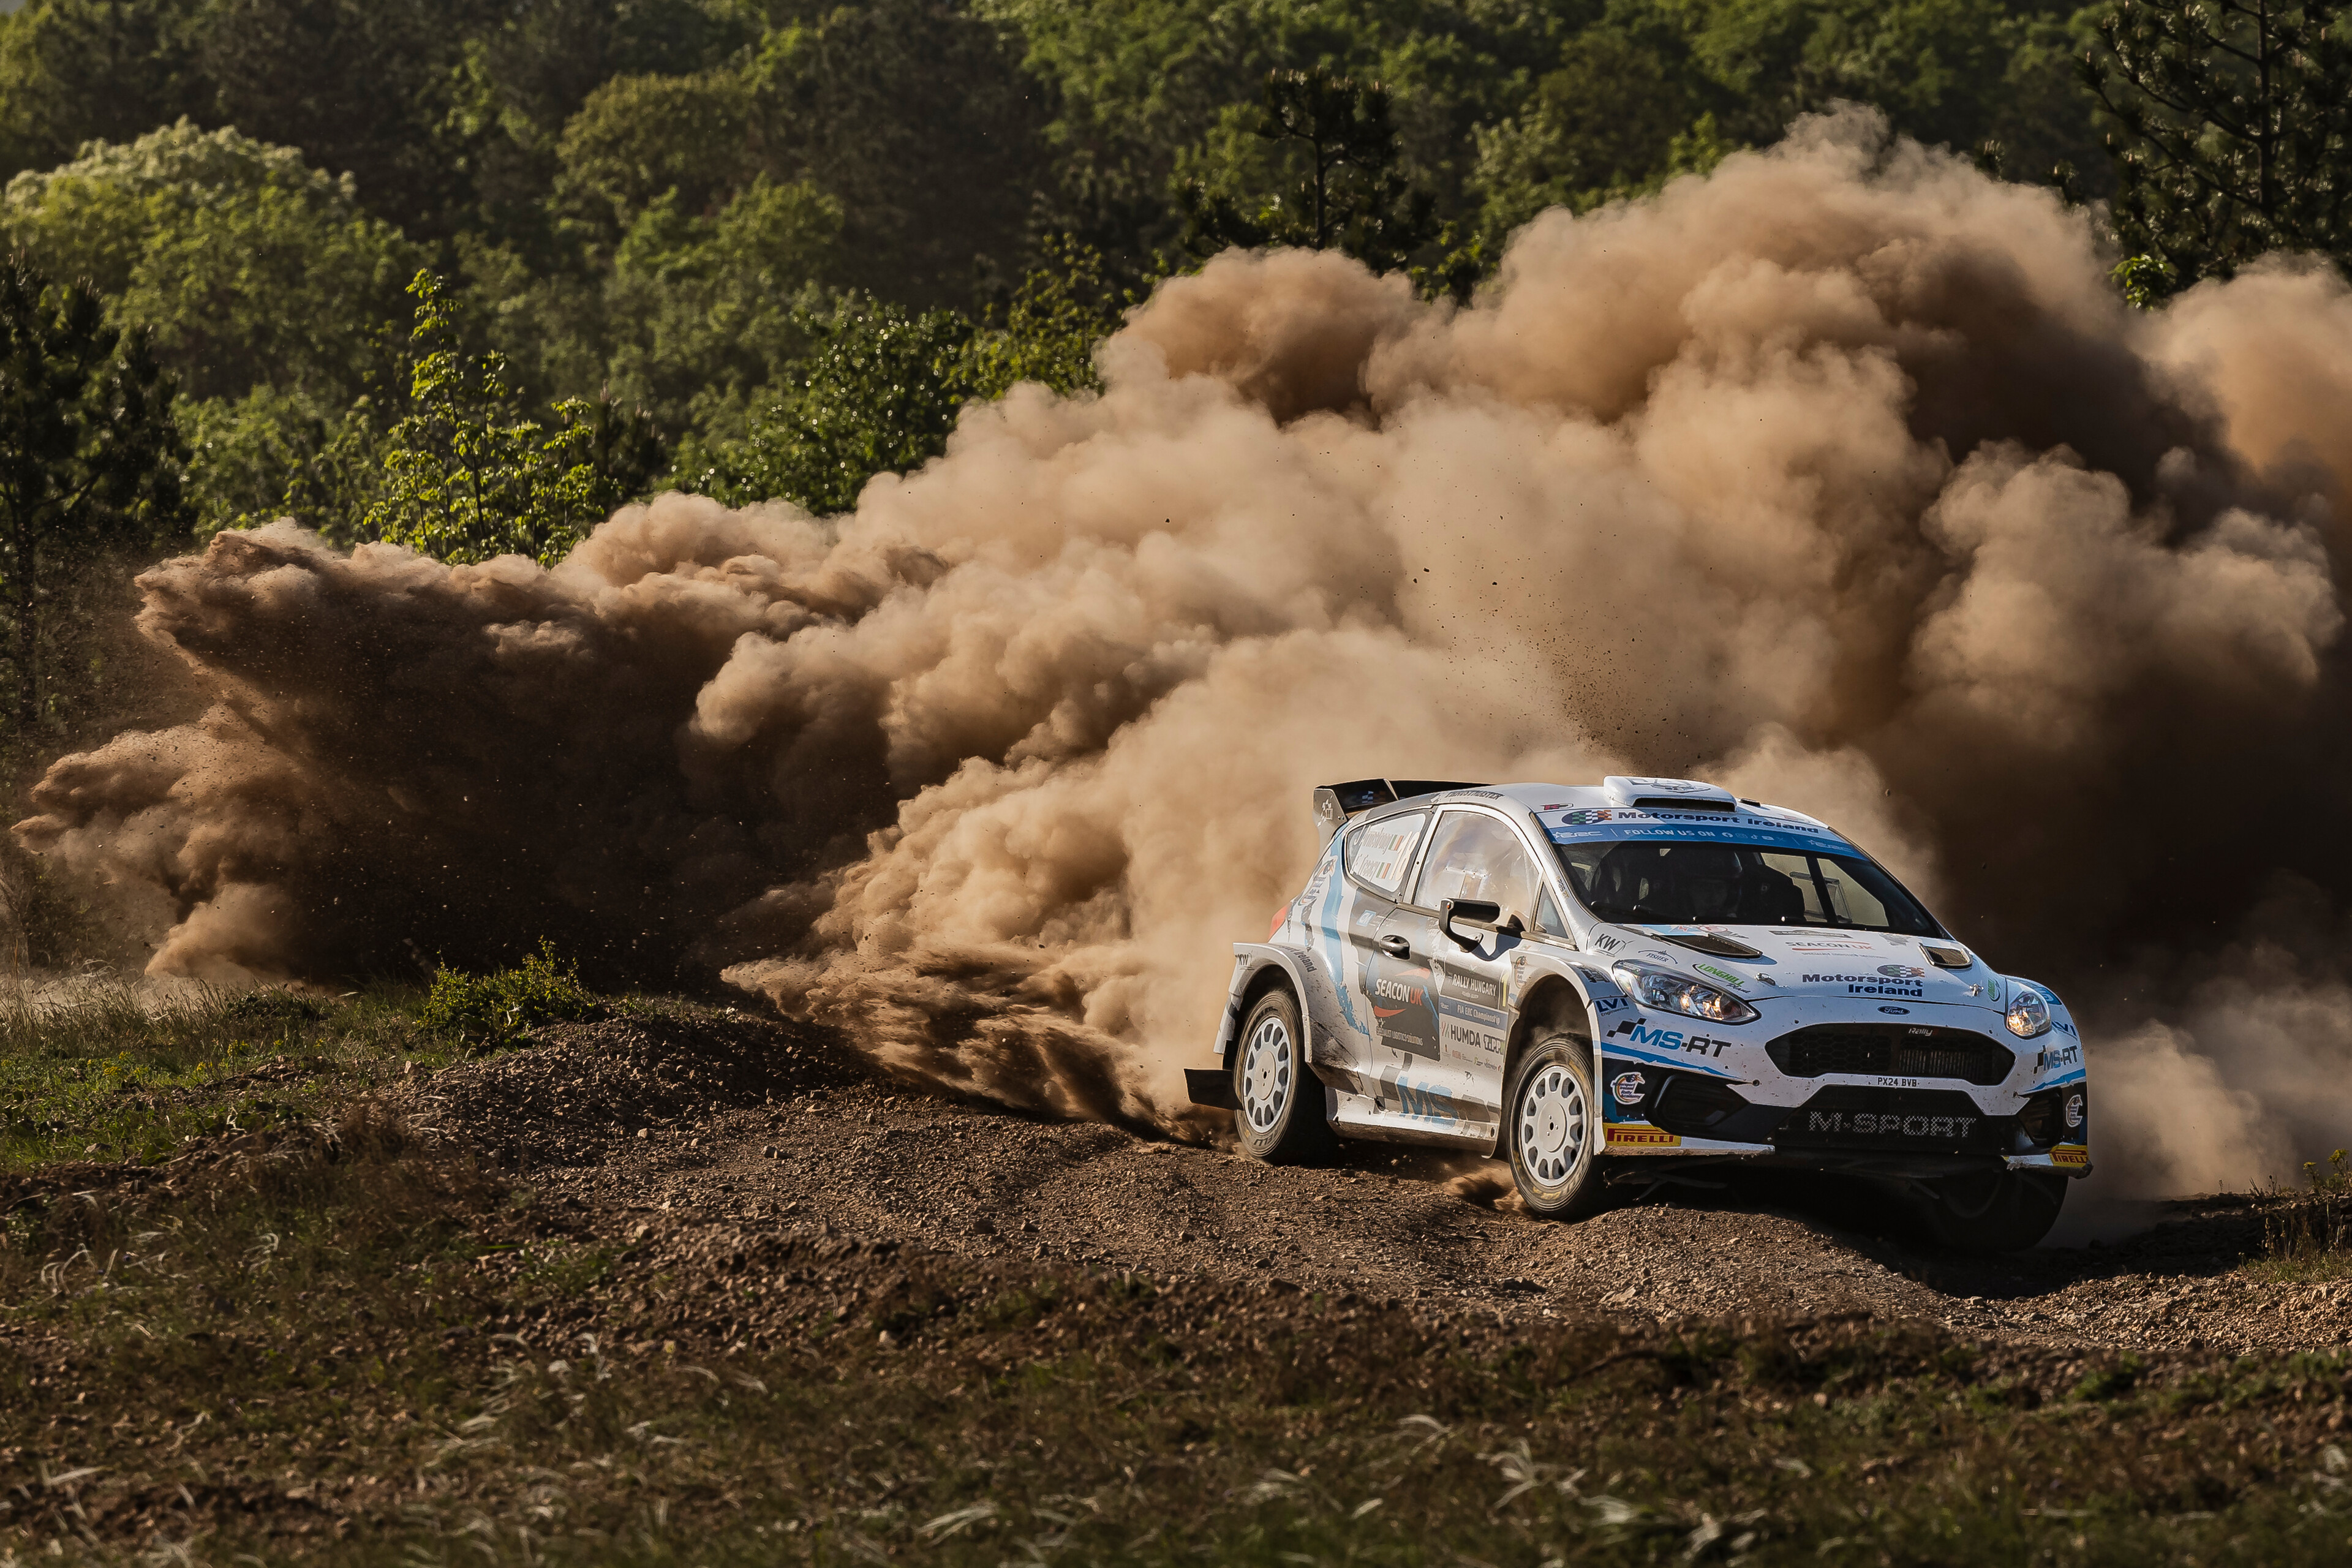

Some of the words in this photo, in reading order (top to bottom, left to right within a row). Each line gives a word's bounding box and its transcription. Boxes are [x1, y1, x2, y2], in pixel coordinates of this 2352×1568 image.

[1618, 811, 1741, 824] Motorsport
[1747, 818, 1819, 834] Ireland
[1389, 831, 1420, 882] 18
[1594, 933, 1620, 952] KW
[1293, 951, 1317, 973] Ireland
[1646, 953, 1669, 962] FISHER
[1698, 963, 1747, 987] LONGHILL
[1801, 974, 1923, 987] Motorsport
[1374, 979, 1411, 1003] SEACON
[1410, 987, 1425, 1006] UK
[1452, 974, 1469, 989] RALLY
[1470, 978, 1497, 997] HUNGARY
[1726, 983, 1751, 993] Plant
[1848, 984, 1923, 997] Ireland
[1595, 997, 1629, 1012] LVI
[1600, 1007, 1629, 1017] Engineering
[1473, 1009, 1500, 1025] Championship
[1450, 1024, 1481, 1049] HUMDA
[1483, 1034, 1505, 1055] TIPP
[1629, 1025, 1732, 1058] MS-RT
[2043, 1045, 2078, 1071] MS-RT
[1877, 1077, 1899, 1086] PX24
[1901, 1078, 1917, 1087] BVB
[1809, 1112, 1977, 1137] M-SPORT
[1607, 1128, 1675, 1143] PIRELLI
